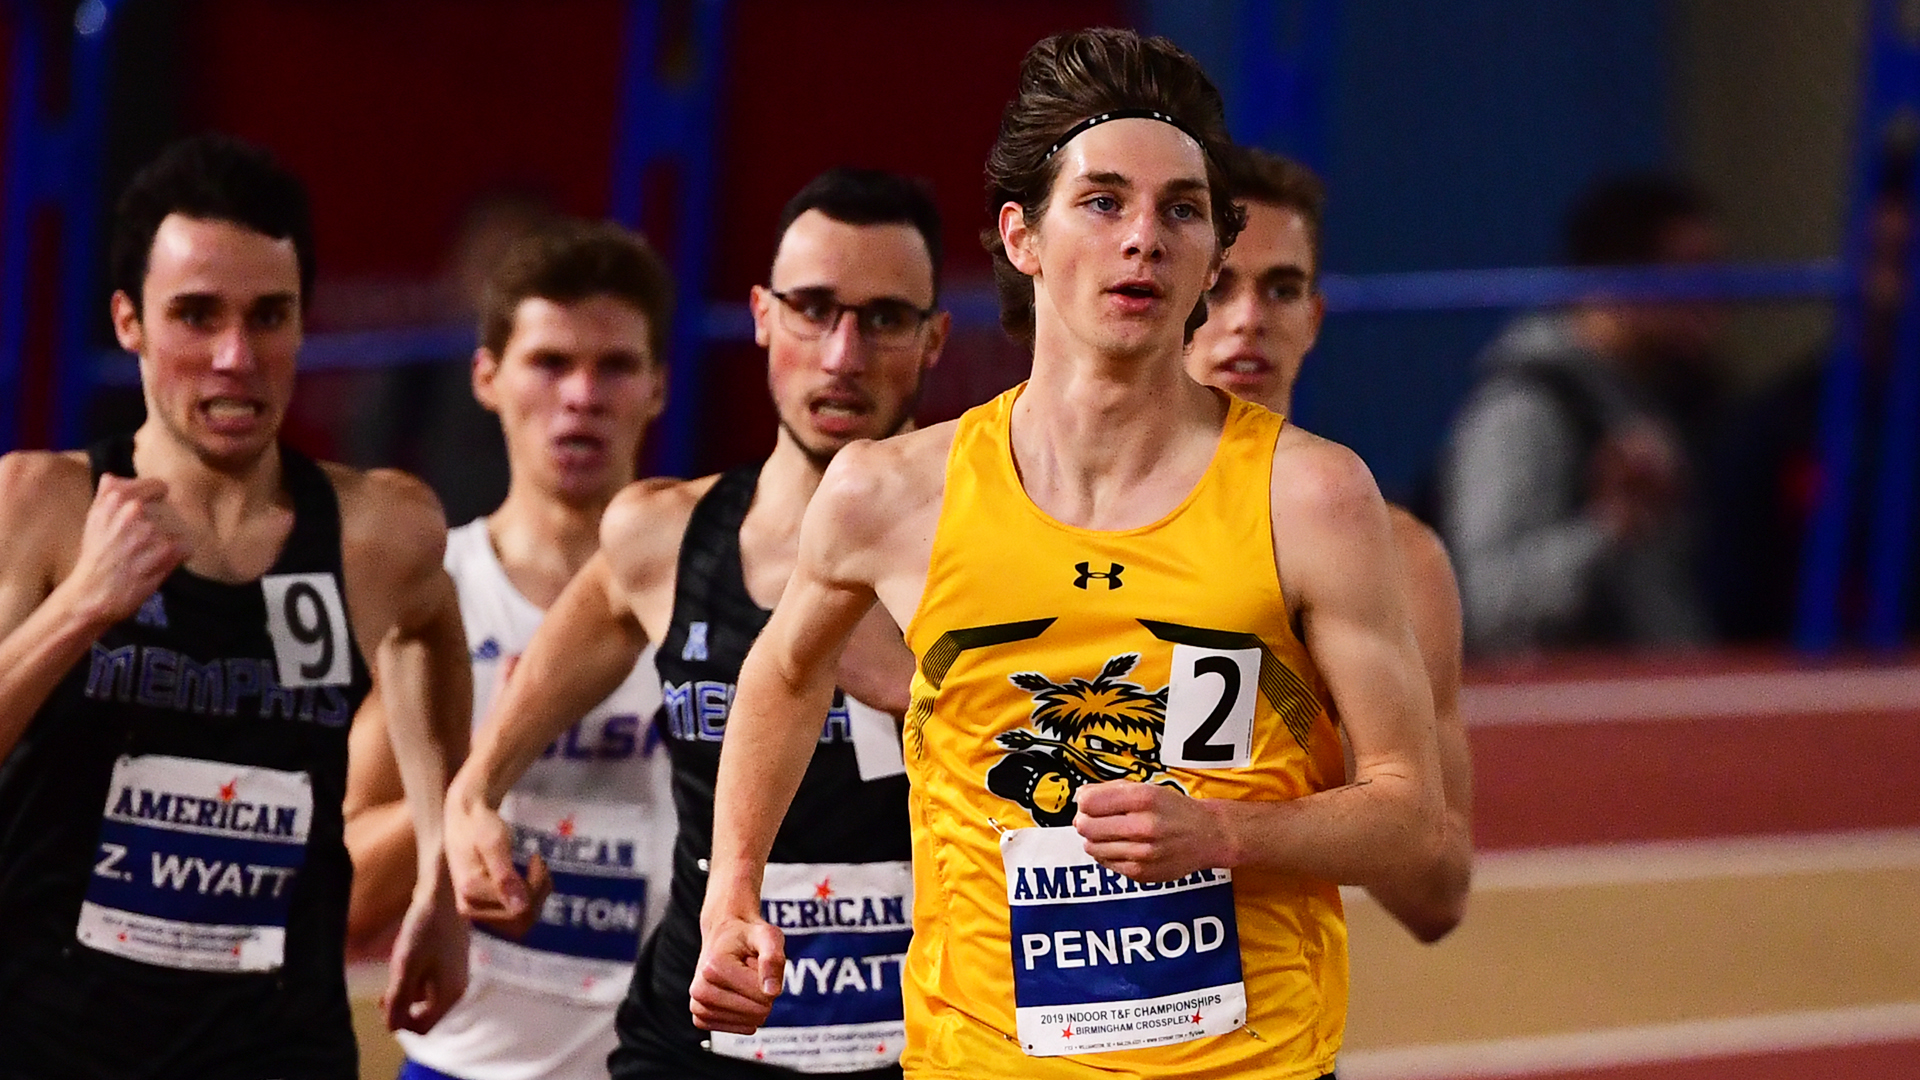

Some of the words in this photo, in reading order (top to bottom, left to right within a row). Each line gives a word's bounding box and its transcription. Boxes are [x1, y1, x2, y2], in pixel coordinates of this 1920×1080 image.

[284, 581, 334, 679] 9
[1181, 655, 1241, 762] 2
[113, 786, 298, 836] AMERICAN
[94, 843, 132, 882] Z.
[151, 851, 297, 897] WYATT
[1014, 863, 1216, 900] AMERI
[761, 895, 906, 929] ERICAN
[1021, 915, 1225, 971] PENROD
[1041, 1013, 1064, 1025] 2019
[1066, 1010, 1108, 1023] INDOOR
[1110, 1008, 1131, 1020] T&F
[1134, 994, 1222, 1018] CHAMPIONSHIPS
[1076, 1022, 1133, 1035] BIRMINGHAM
[1136, 1014, 1190, 1030] CROSSPLEX
